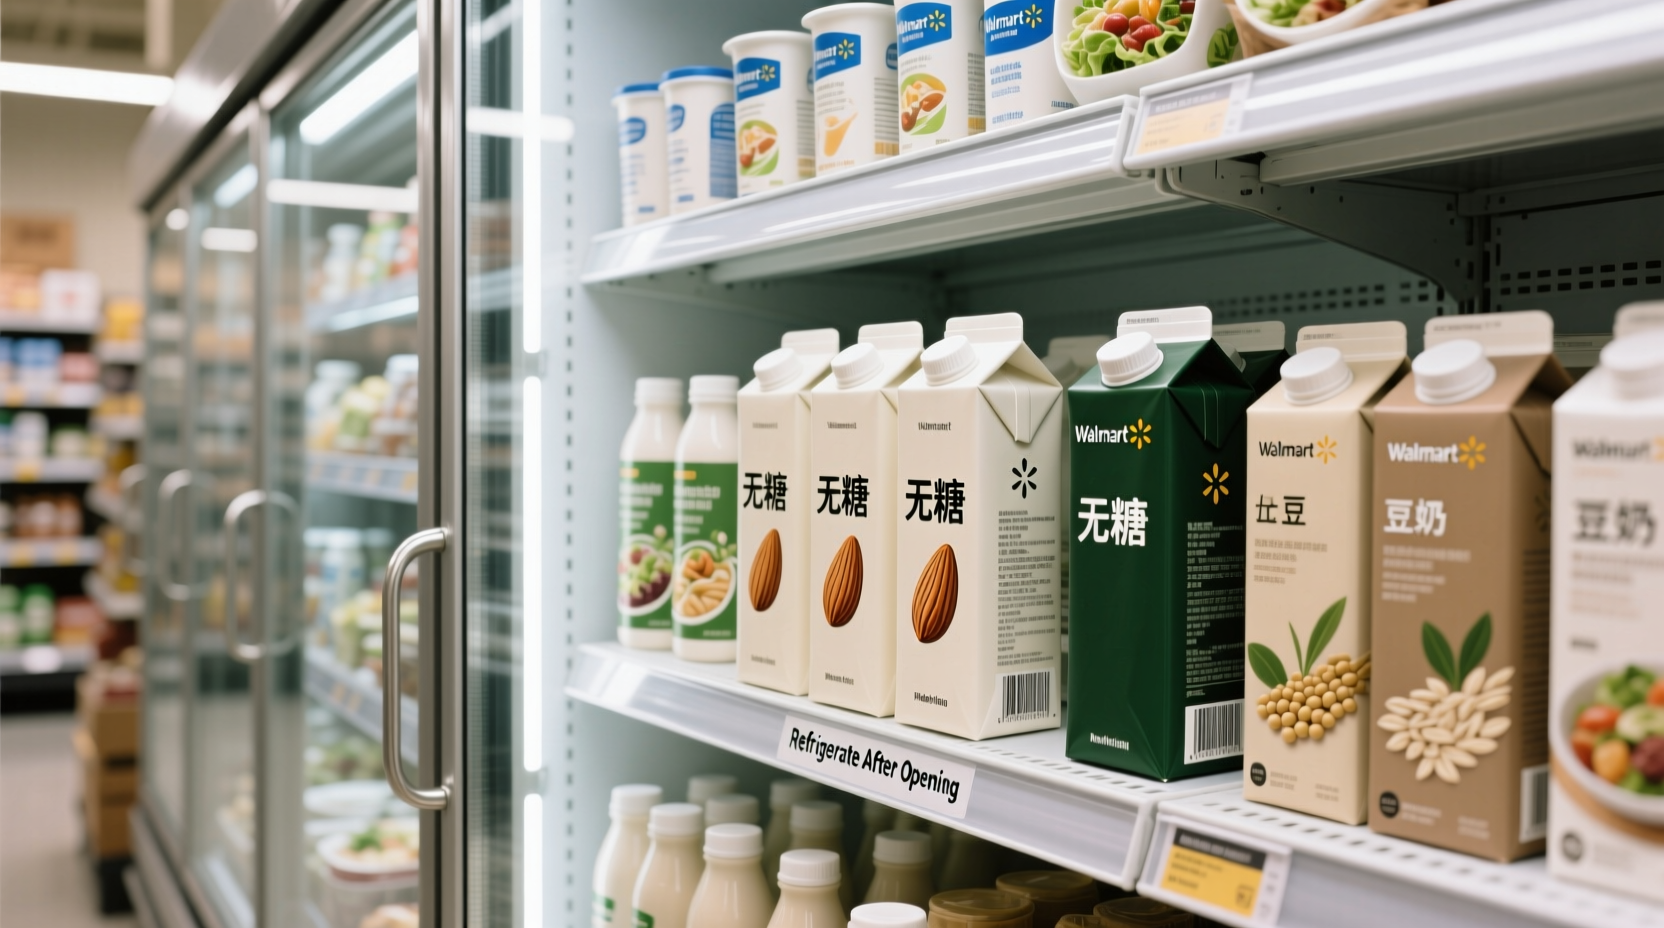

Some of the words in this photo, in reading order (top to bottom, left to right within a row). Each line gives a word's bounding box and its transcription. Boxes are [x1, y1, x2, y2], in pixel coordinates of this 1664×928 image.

[1075, 424, 1129, 443] Walmart
[1258, 440, 1315, 458] Walmart
[1387, 442, 1459, 463] Walmart
[742, 471, 788, 512] 无糖
[816, 474, 870, 518] 无糖
[905, 478, 966, 525] 无糖
[1077, 496, 1149, 547] 无糖
[1383, 498, 1448, 538] 豆奶
[788, 727, 860, 768] Refrigerate
[861, 748, 898, 778] After
[900, 759, 960, 804] Opening
